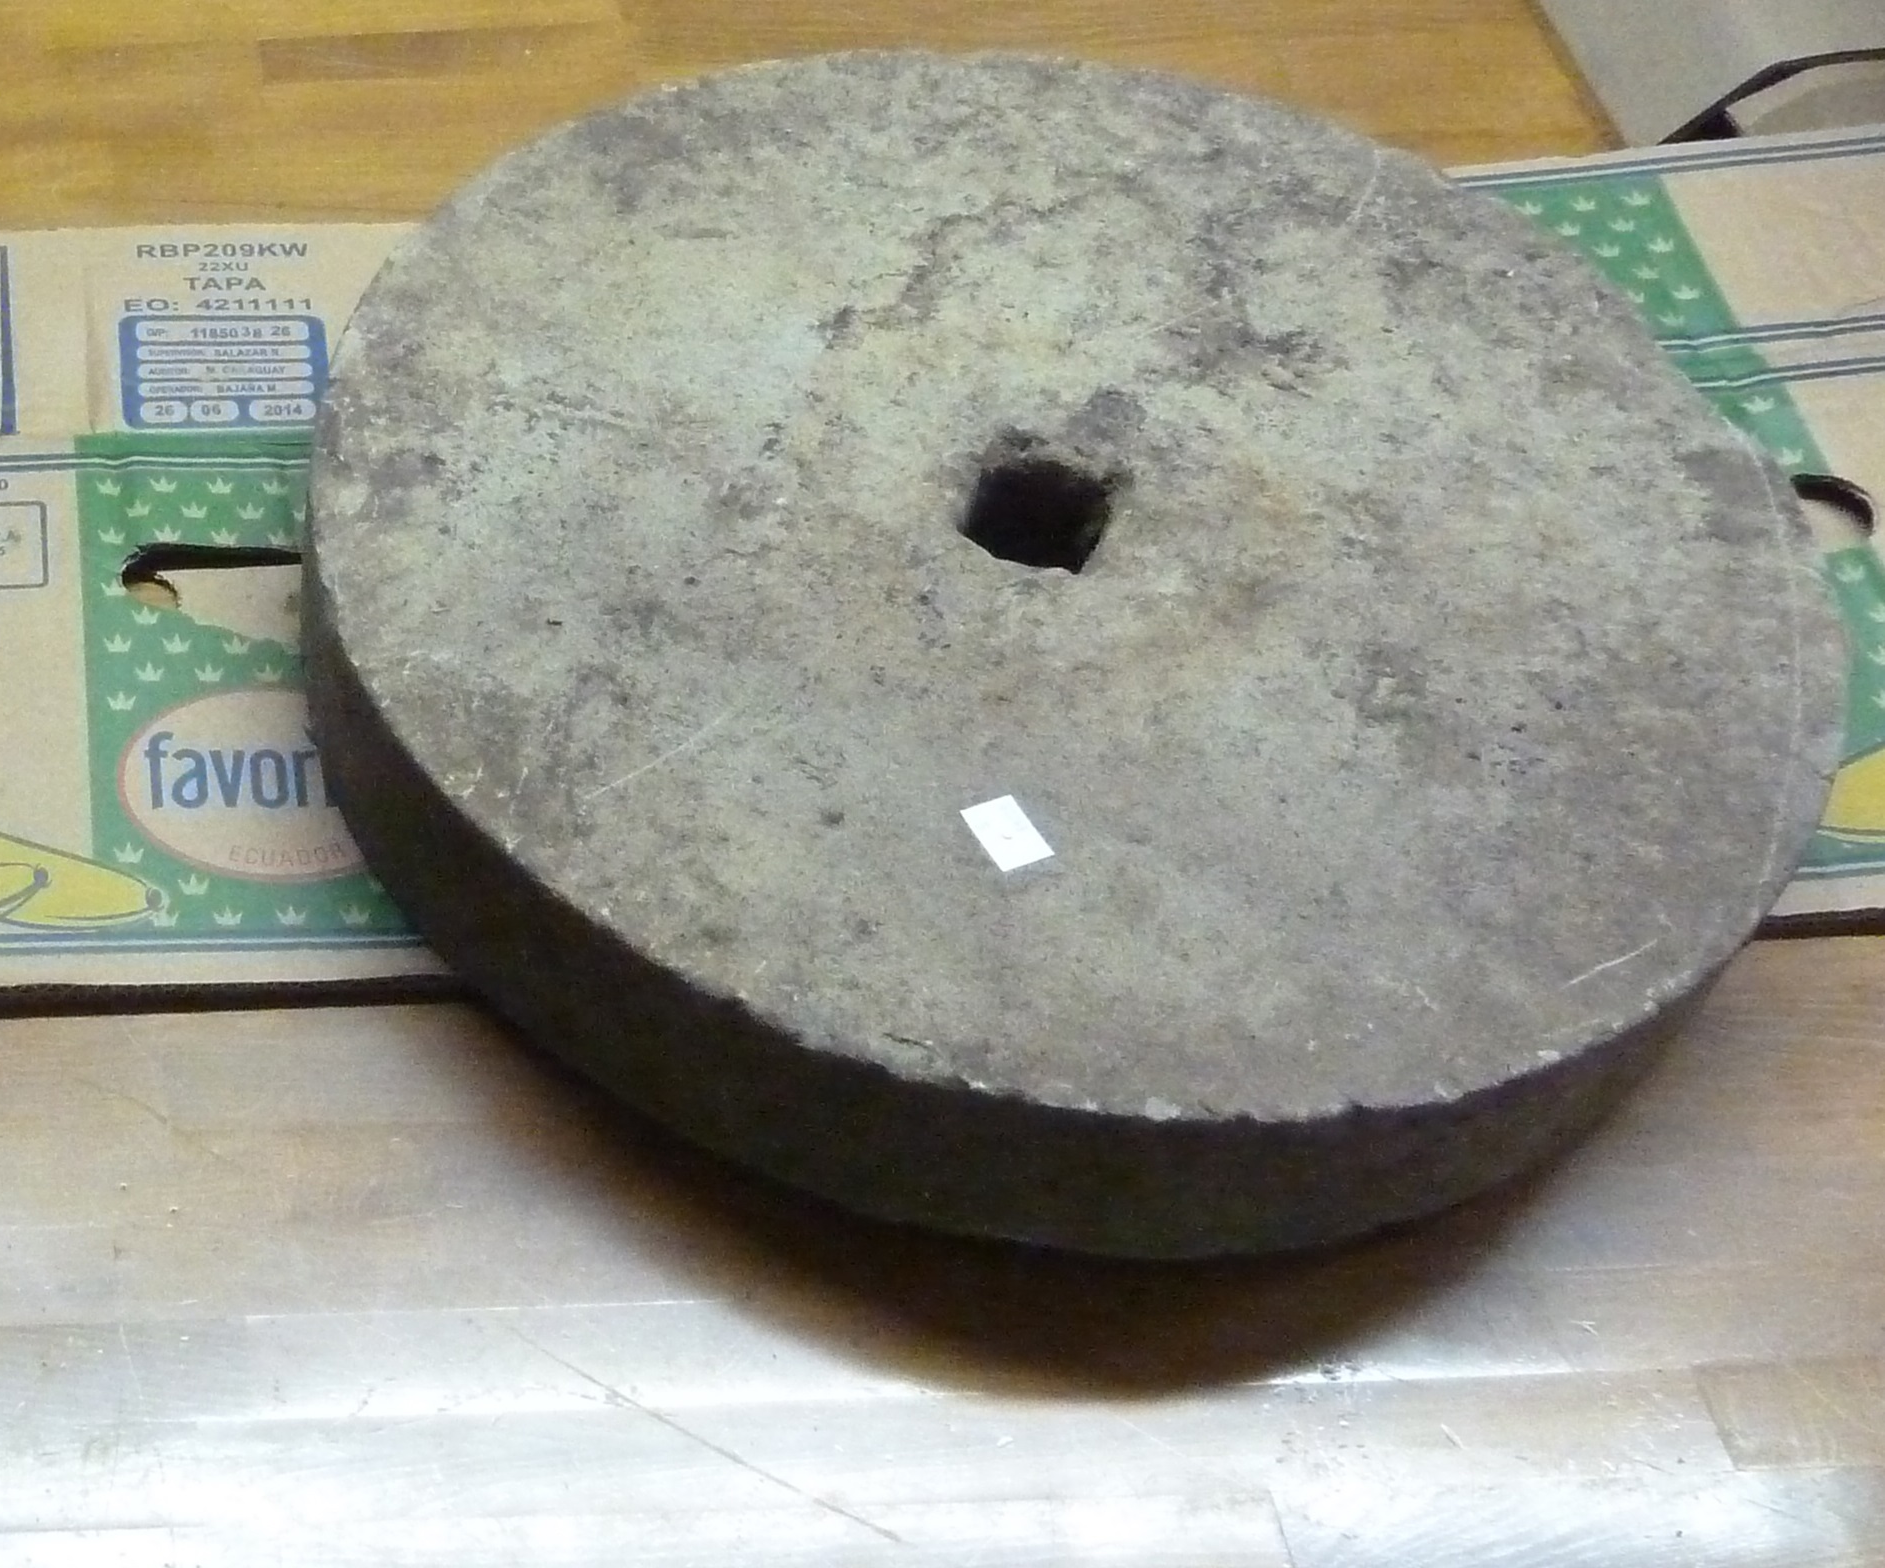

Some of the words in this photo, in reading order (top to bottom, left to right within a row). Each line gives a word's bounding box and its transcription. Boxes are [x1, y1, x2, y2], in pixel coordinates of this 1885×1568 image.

[136, 243, 308, 258] RBP209KW
[198, 262, 249, 272] 22XU
[183, 276, 267, 291] TAPA
[123, 299, 179, 312] EO:
[196, 298, 312, 311] 4211111
[154, 404, 175, 416] 26
[264, 403, 303, 417] 2014
[228, 843, 347, 868] ECUADOR
